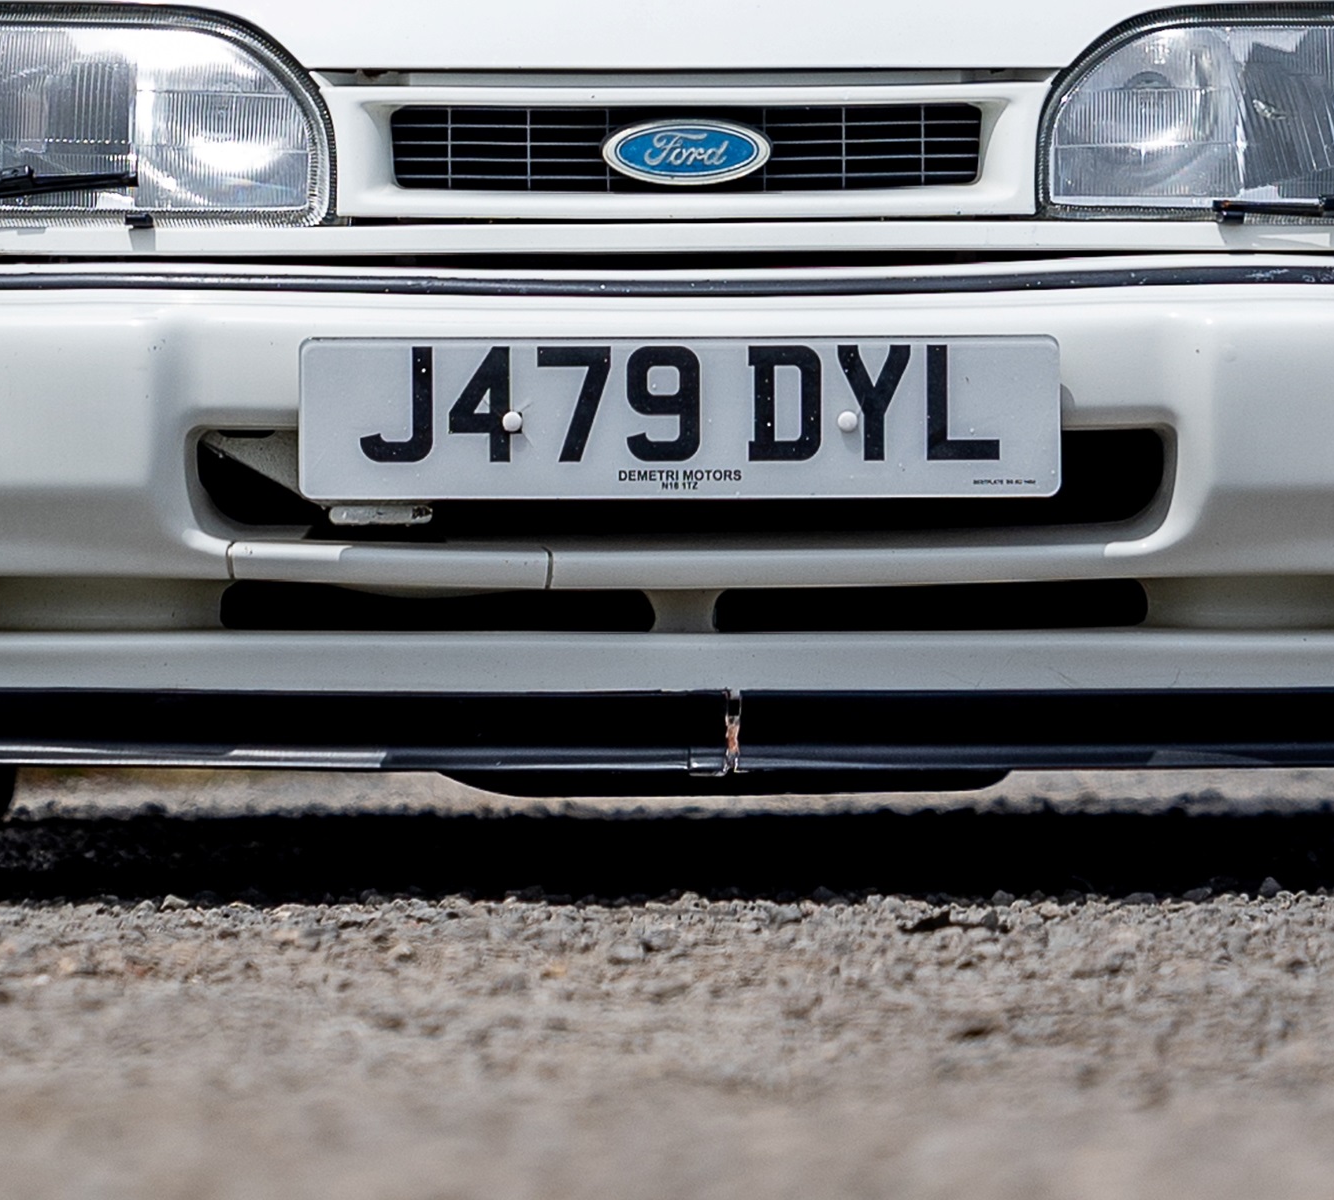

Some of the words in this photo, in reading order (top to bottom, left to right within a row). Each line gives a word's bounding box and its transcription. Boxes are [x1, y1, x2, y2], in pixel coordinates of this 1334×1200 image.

[643, 131, 729, 166] Ford
[360, 346, 701, 463] J479
[748, 345, 1000, 462] DYL
[618, 470, 679, 481] DEMETRI
[683, 469, 742, 481] MOTORS
